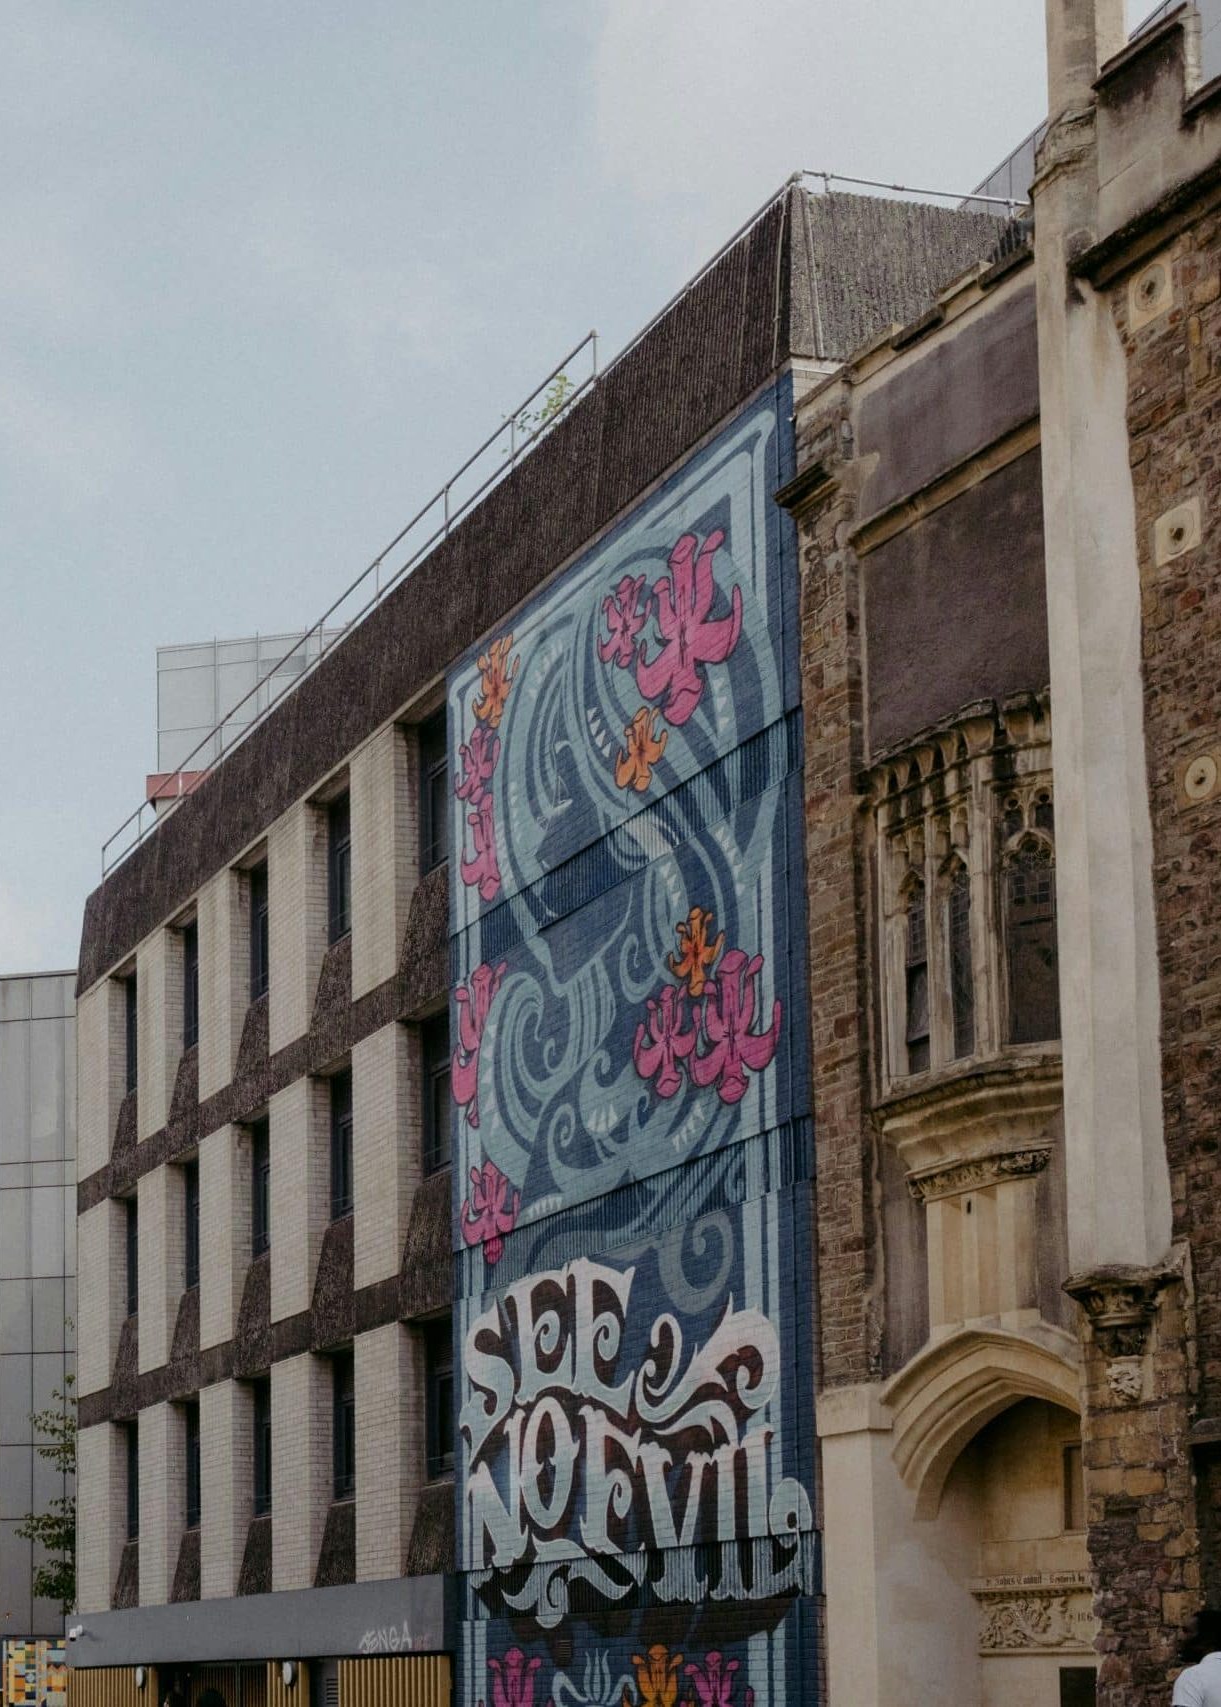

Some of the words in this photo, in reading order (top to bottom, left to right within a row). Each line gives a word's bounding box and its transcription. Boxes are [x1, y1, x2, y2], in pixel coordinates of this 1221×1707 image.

[460, 1257, 636, 1466] SEE
[467, 1396, 579, 1591] NO
[578, 1402, 814, 1603] EVIL
